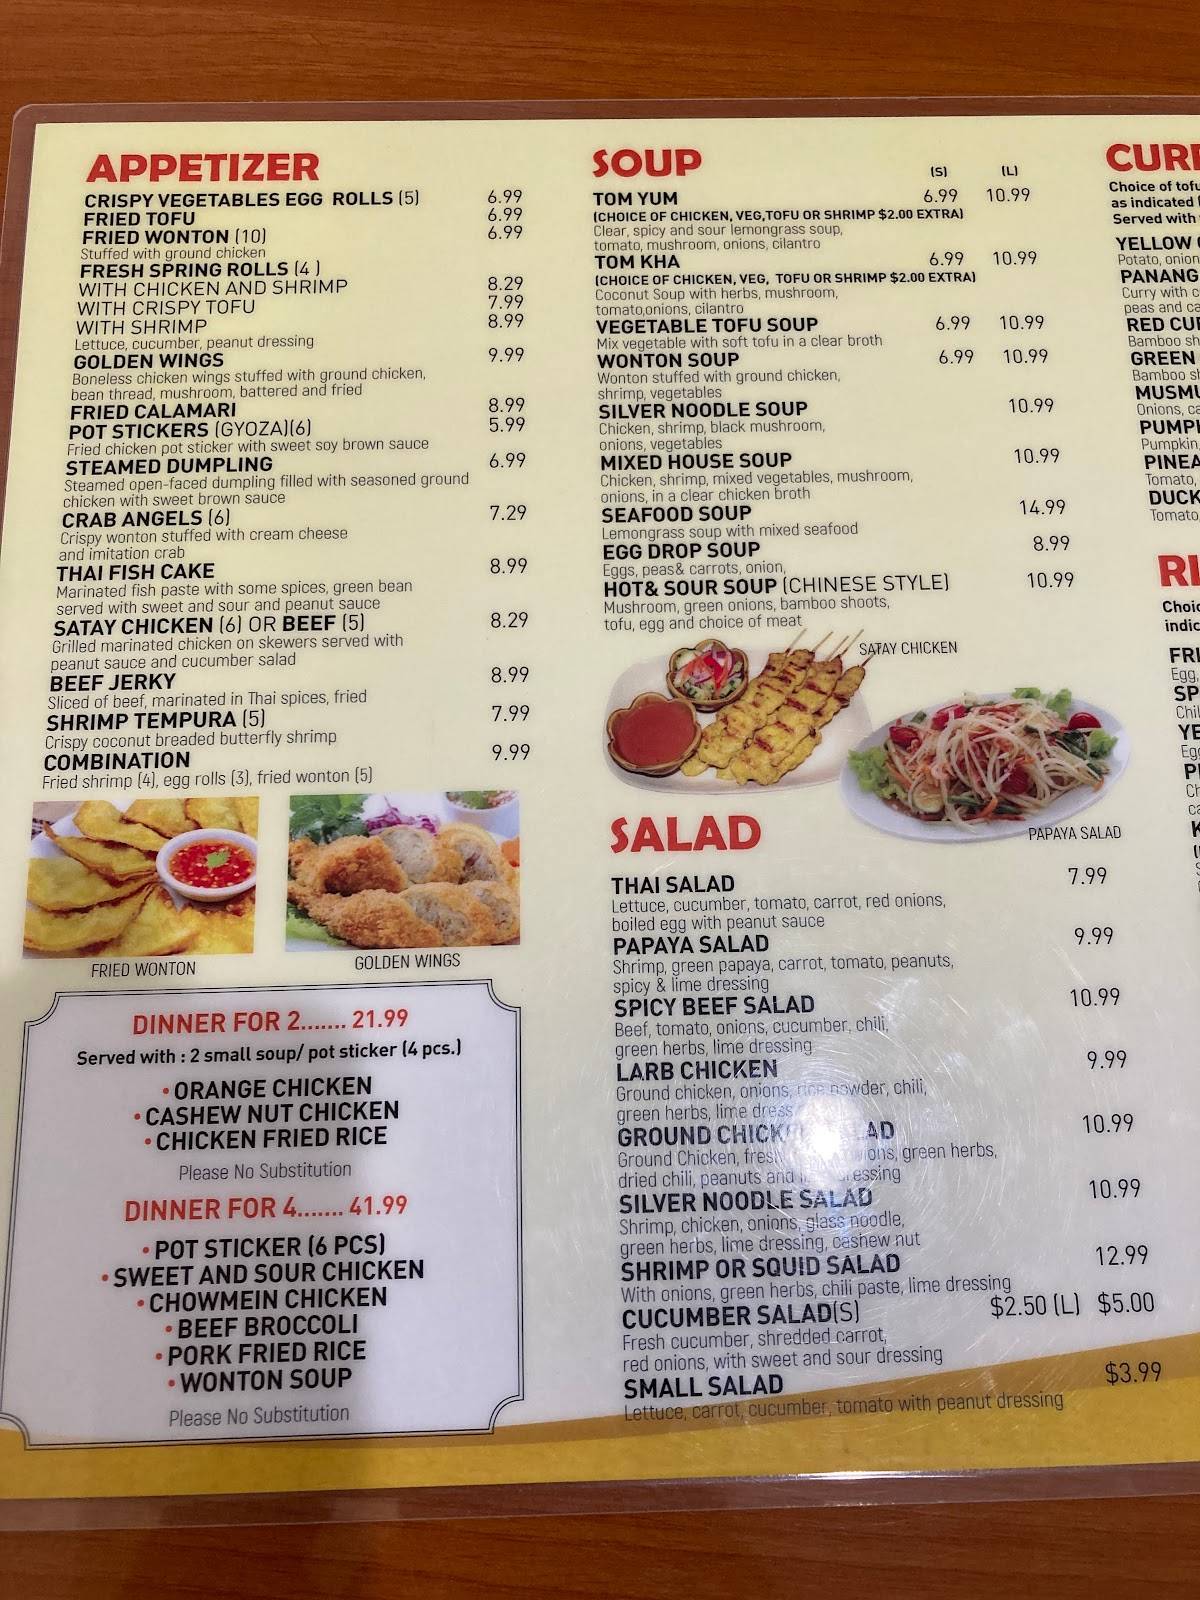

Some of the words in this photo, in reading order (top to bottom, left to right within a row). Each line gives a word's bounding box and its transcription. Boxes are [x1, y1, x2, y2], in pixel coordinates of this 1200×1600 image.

[86, 152, 320, 182] APPETIZER
[592, 148, 703, 178] SOUP
[1001, 165, 1019, 177] (L)
[930, 166, 948, 178] (S)
[1109, 181, 1155, 192] Choice
[1160, 181, 1172, 191] of
[85, 194, 153, 208] CRISPY
[158, 193, 279, 207] VEGETABLES
[286, 192, 322, 206] EGG
[333, 191, 393, 205] ROLLS
[399, 190, 418, 206] (5)
[488, 190, 522, 203] 6.99
[593, 192, 632, 206] TOM
[638, 192, 677, 205] YUM
[924, 189, 957, 202] 6.99
[987, 188, 1030, 202] 10.99
[594, 211, 647, 224] (CHOICE
[651, 212, 666, 221] OF
[671, 211, 732, 222] CHICKEN,
[736, 210, 799, 221] VEG,TOFU
[803, 210, 820, 220] OR
[824, 210, 875, 220] SHRIMP
[879, 209, 913, 220] $2.00
[917, 208, 963, 219] EXTRA)
[83, 231, 139, 244] FRIED
[145, 230, 228, 244] WONTON
[236, 228, 265, 244] (10)
[488, 225, 522, 239] 6.99
[1116, 236, 1191, 250] YELLOW
[81, 248, 128, 259] Stuffed
[134, 248, 160, 259] with
[166, 247, 211, 262] ground
[217, 247, 265, 258] chicken
[1118, 254, 1161, 266] Potato,
[488, 276, 523, 290] 8.29
[1121, 269, 1198, 283] PANANG
[79, 283, 126, 297] WITH
[134, 282, 219, 296] CHICKEN
[225, 281, 266, 295] AND
[273, 280, 347, 294] SHRIMP
[596, 319, 707, 334] VEGETABLE
[712, 318, 761, 332] TOFU
[767, 318, 818, 332] SOUP
[936, 316, 970, 330] 6.99
[1000, 315, 1044, 329] 10.99
[74, 354, 153, 369] GOLDEN
[159, 353, 223, 368] WINGS
[489, 348, 524, 362] 9.99
[1131, 351, 1195, 365] GREEN
[72, 389, 103, 401] bean
[110, 388, 155, 400] thread,
[161, 387, 235, 399] mushroom,
[241, 385, 297, 397] battered
[302, 384, 326, 396] and
[332, 383, 362, 395] fried
[69, 425, 107, 440] POT
[112, 423, 208, 439] STICKERS
[216, 419, 310, 438] (GYOZA)(6)
[490, 417, 525, 432] 5.99
[1142, 438, 1200, 452] Pumpkin,
[490, 453, 525, 468] 6.99
[601, 455, 662, 471] MIXED
[669, 454, 734, 469] HOUSE
[740, 452, 792, 468] SOUP
[1015, 448, 1059, 463] 10.99
[66, 459, 160, 476] STEAMED
[167, 457, 272, 473] DUMPLING
[1145, 474, 1196, 486] Tomato,
[1149, 490, 1200, 505] DUCK
[63, 512, 116, 528] CRAB
[121, 510, 202, 527] ANGELS
[209, 508, 229, 526] (6)
[490, 505, 527, 520] 7.29
[61, 532, 102, 547] Crispy
[107, 532, 156, 543] wonton
[162, 529, 211, 542] stuffed
[216, 528, 244, 541] with
[250, 530, 293, 540] cream
[299, 527, 347, 539] cheese
[603, 528, 684, 541] Lemongrass
[690, 528, 721, 540] soup
[726, 524, 754, 536] with
[760, 523, 799, 536] mixed
[804, 522, 858, 535] seafood
[605, 581, 659, 597] HOT&
[664, 580, 718, 596] SOUR
[724, 578, 777, 595] SOUP
[783, 576, 877, 595] (CHINESE
[883, 573, 949, 592] STYLE)
[1028, 572, 1073, 588] 10.99
[54, 620, 116, 636] SATAY
[122, 617, 213, 635] CHICKEN
[220, 615, 241, 634] (6)
[249, 616, 276, 632] OR
[283, 615, 336, 631] BEEF
[343, 613, 364, 632] (5)
[491, 612, 528, 628] 8.29
[859, 642, 898, 655] SATAY
[901, 641, 958, 655] CHICKEN
[492, 744, 530, 760] 9.99
[44, 752, 190, 771] COMBINATION
[611, 815, 761, 853] SALAD
[1028, 826, 1077, 841] PAPAYA
[1081, 826, 1121, 839] SALAD
[1068, 867, 1106, 885] 7.99
[611, 877, 659, 894] THAI
[666, 875, 734, 893] SALAD
[91, 962, 130, 977] FRIED
[135, 961, 196, 976] WONTON
[355, 955, 410, 970] GOLDEN
[416, 953, 461, 968] WINGS
[1071, 988, 1119, 1006] 10.99
[615, 998, 676, 1017] SPICY
[683, 997, 737, 1016] BEEF
[744, 995, 814, 1014] SALAD
[134, 1013, 225, 1034] DINNER
[234, 1012, 279, 1032] FOR
[353, 1009, 408, 1028] 21.99
[77, 1050, 135, 1065] Served
[140, 1049, 175, 1064] with
[190, 1048, 200, 1063] 2
[204, 1047, 251, 1062] small
[256, 1044, 304, 1064] soup/
[309, 1045, 335, 1063] pot
[339, 1043, 397, 1058] sticker
[403, 1040, 418, 1057] (4
[423, 1038, 461, 1059] pcs.)
[146, 1105, 241, 1126] CASHEW
[248, 1104, 293, 1123] NUT
[300, 1101, 398, 1121] CHICKEN
[180, 1165, 228, 1180] Please
[235, 1164, 253, 1179] No
[260, 1161, 351, 1178] Substitution
[114, 1266, 194, 1287] SWEET
[199, 1265, 247, 1284] AND
[254, 1263, 315, 1283] SOUR
[323, 1260, 423, 1281] CHICKEN
[990, 1295, 1047, 1318] $2.50
[1053, 1293, 1080, 1317] (L)
[1098, 1292, 1154, 1316] $5.00
[623, 1306, 751, 1329] CUCUMBER
[757, 1300, 860, 1325] SALAD(S)
[178, 1318, 238, 1338] BEEF
[245, 1314, 357, 1336] BROCCOLI
[1105, 1361, 1162, 1385] $3.99
[624, 1377, 702, 1399] SMALL
[708, 1374, 783, 1396] SALAD
